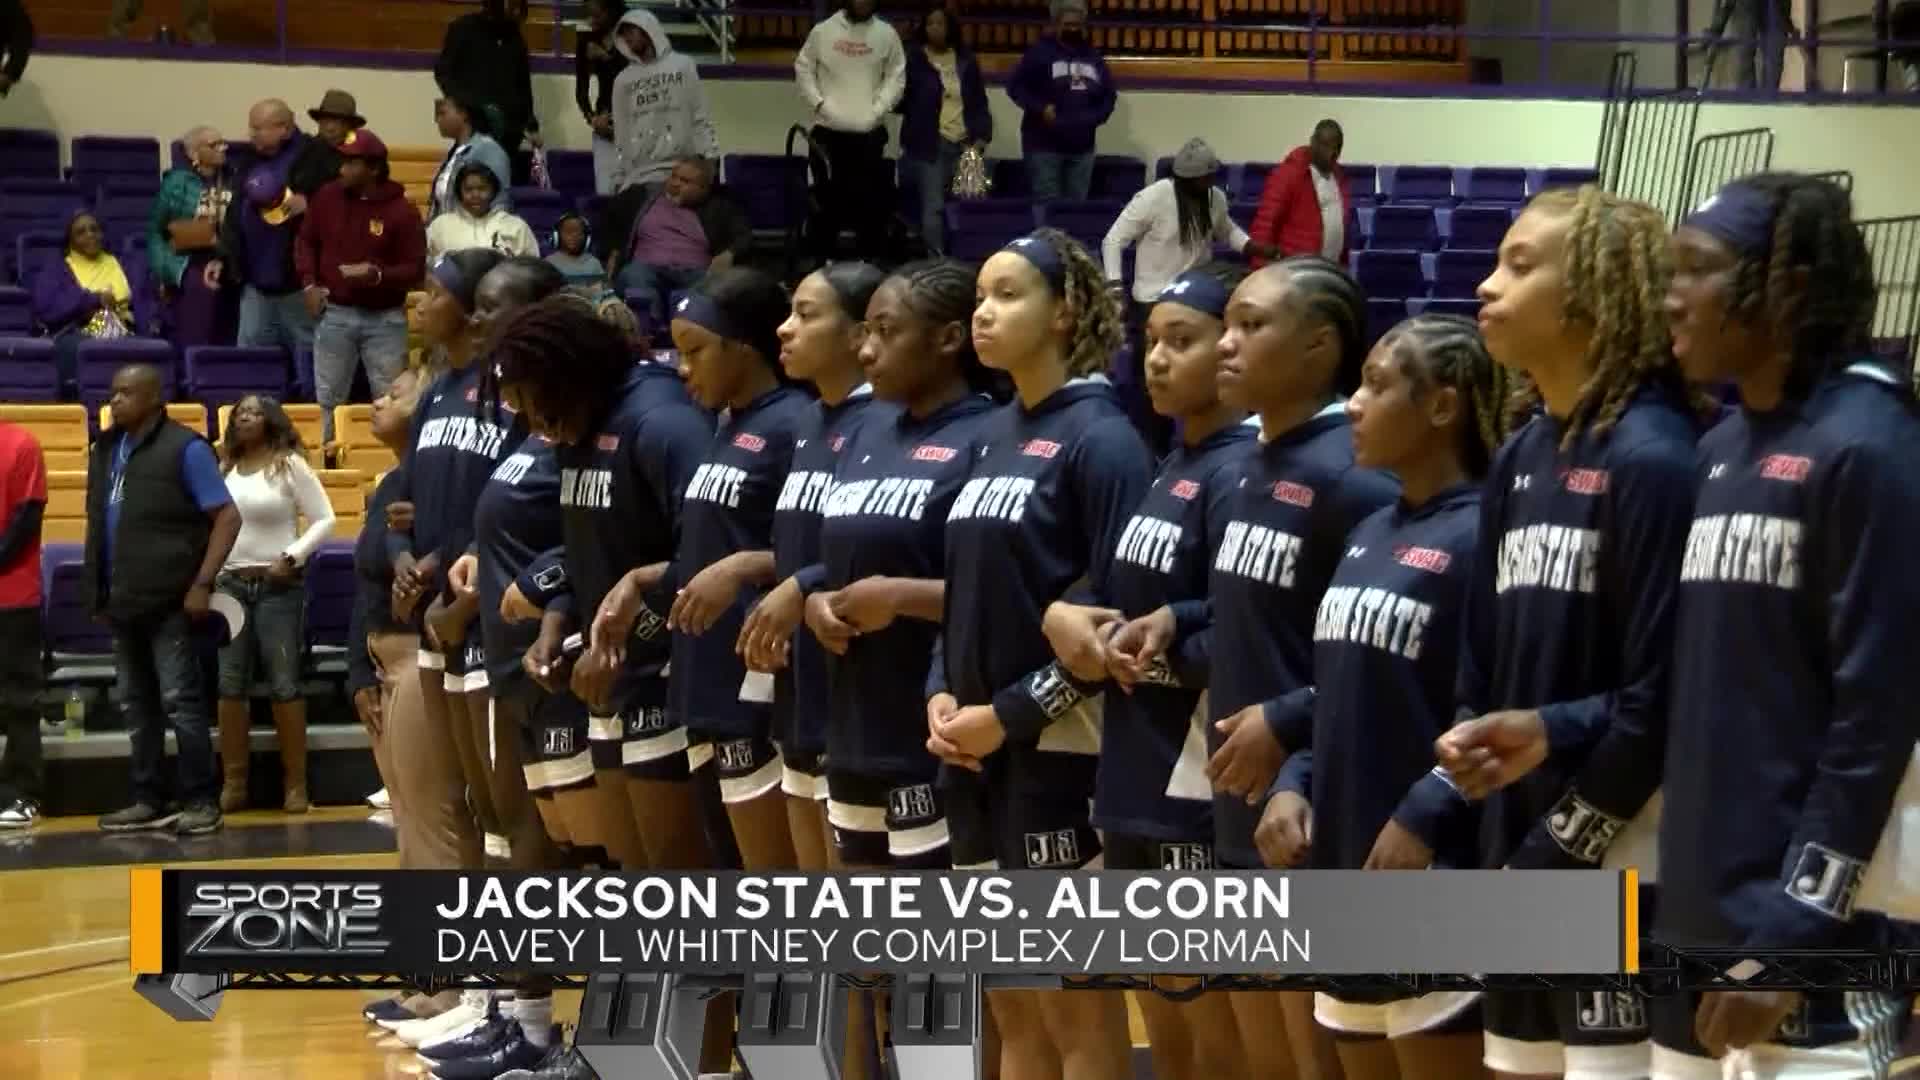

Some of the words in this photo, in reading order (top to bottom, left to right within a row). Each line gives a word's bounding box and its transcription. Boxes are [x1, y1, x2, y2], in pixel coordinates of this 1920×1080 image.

[864, 478, 935, 520] STATE
[1127, 516, 1183, 574] STATE
[1236, 525, 1303, 588] STATE
[1530, 523, 1600, 593] STATE
[1719, 513, 1804, 588] STATE
[1350, 587, 1432, 660] STATE
[1028, 831, 1076, 864] JSU
